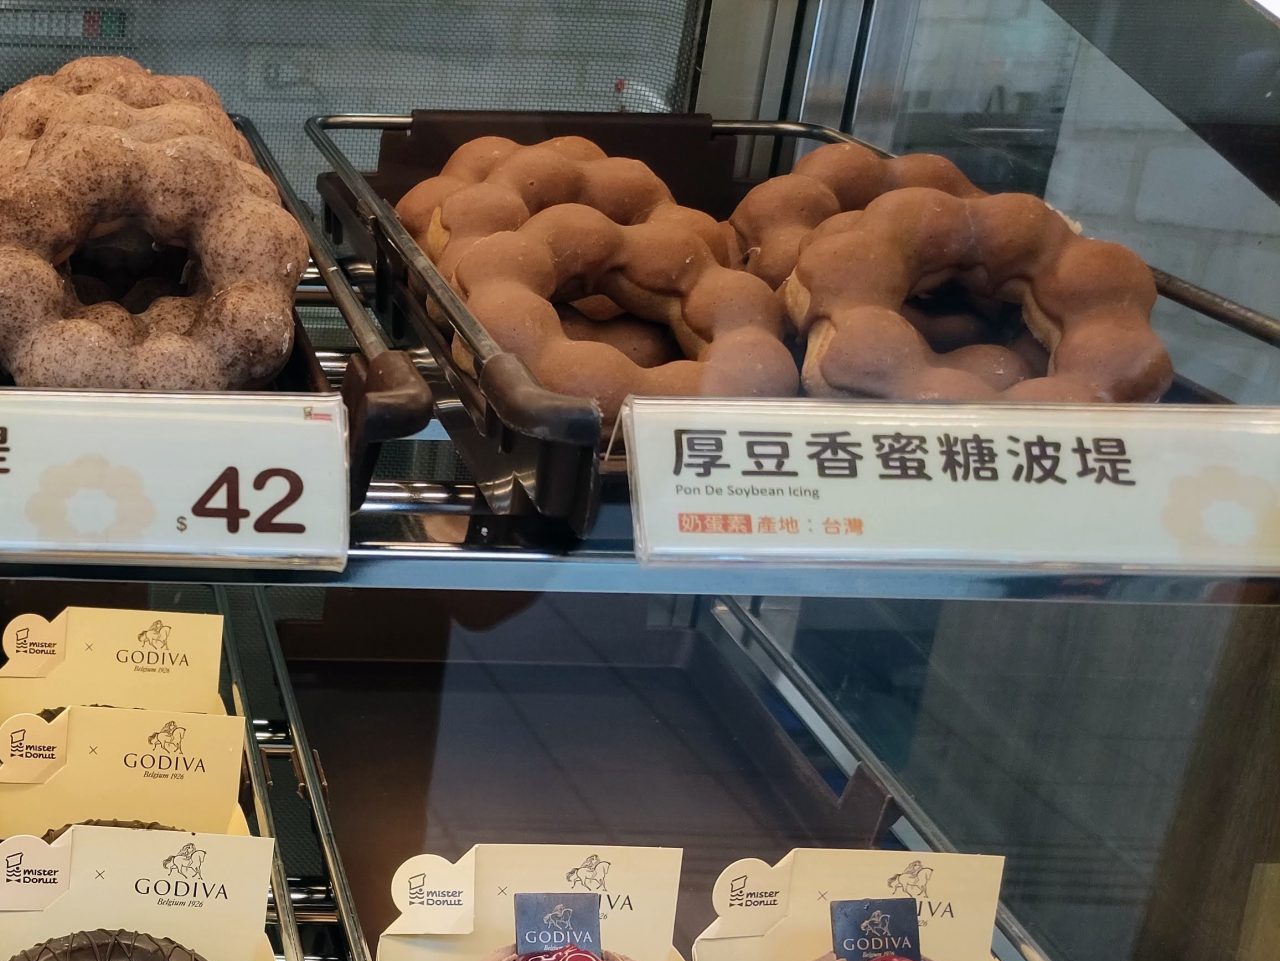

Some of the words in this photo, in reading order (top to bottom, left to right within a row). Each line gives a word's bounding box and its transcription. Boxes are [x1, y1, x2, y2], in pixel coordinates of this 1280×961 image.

[673, 428, 1137, 487] 厚豆香蜜糖波堤
[676, 485, 701, 496] Pon
[705, 485, 723, 496] De
[728, 485, 784, 499] Soybean
[788, 486, 820, 500] Icing
[680, 514, 749, 533] 奶蛋素
[116, 649, 189, 667] GODIVA
[123, 753, 206, 773] GODIVA
[143, 770, 169, 779] Belgium
[134, 878, 228, 900] GODIVA
[157, 898, 186, 907] Belgium
[188, 900, 204, 908] 1926
[525, 930, 593, 943] GODIVA
[843, 937, 912, 951] GODIVA
